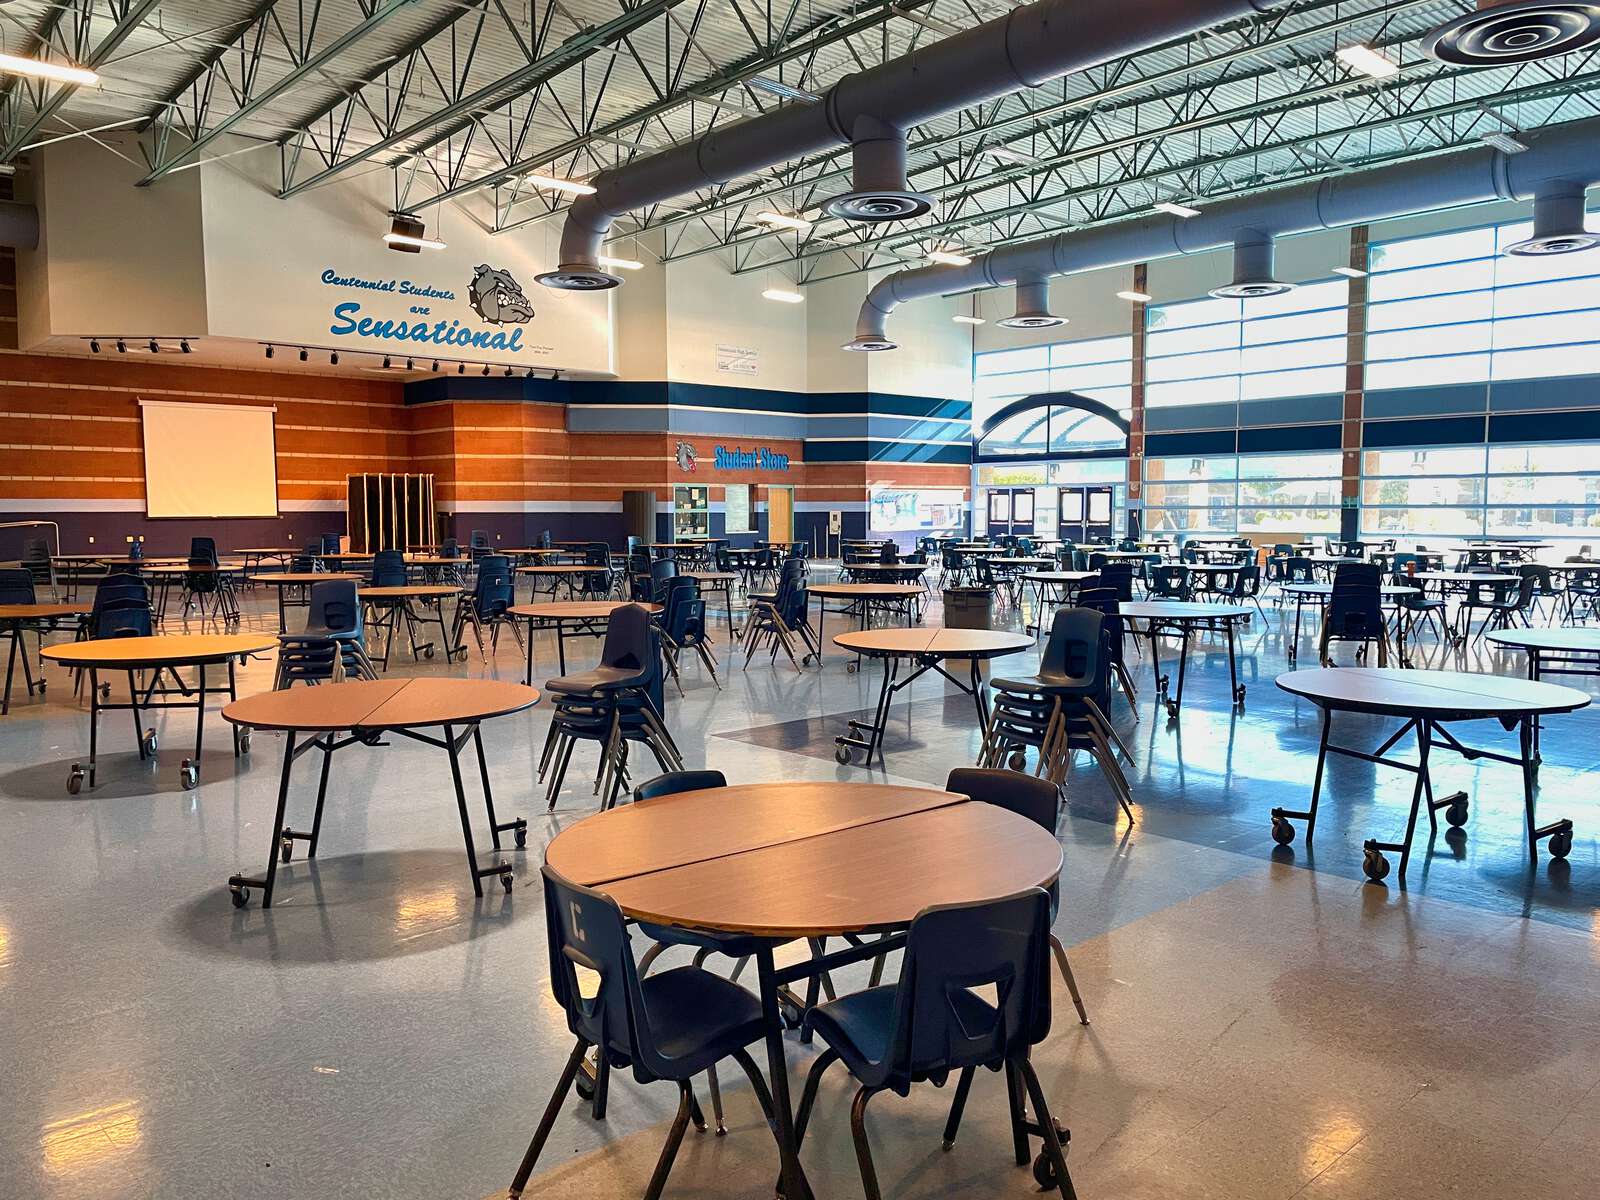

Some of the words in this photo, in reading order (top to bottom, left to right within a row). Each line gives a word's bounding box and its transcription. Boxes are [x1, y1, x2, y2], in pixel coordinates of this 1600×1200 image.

[321, 269, 396, 292] Centennial
[399, 281, 455, 300] Students
[409, 306, 430, 315] are
[330, 302, 524, 352] Sensational
[714, 446, 758, 470] Student
[760, 447, 789, 472] Store
